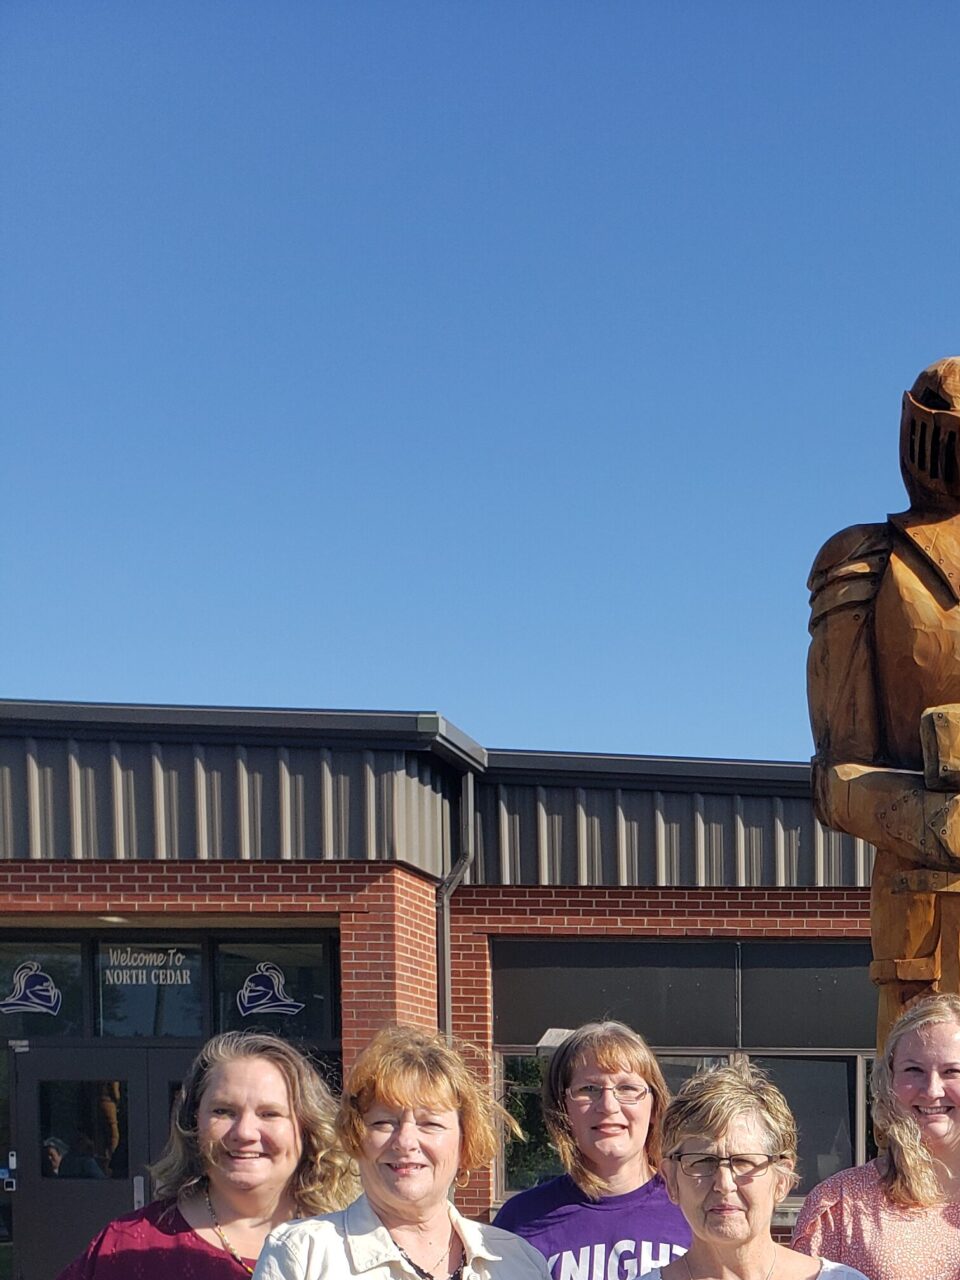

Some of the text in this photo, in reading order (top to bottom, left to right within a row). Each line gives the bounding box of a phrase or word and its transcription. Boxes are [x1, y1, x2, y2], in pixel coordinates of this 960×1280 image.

[109, 947, 186, 967] Welcome To
[105, 969, 191, 985] NORTH CEDAR
